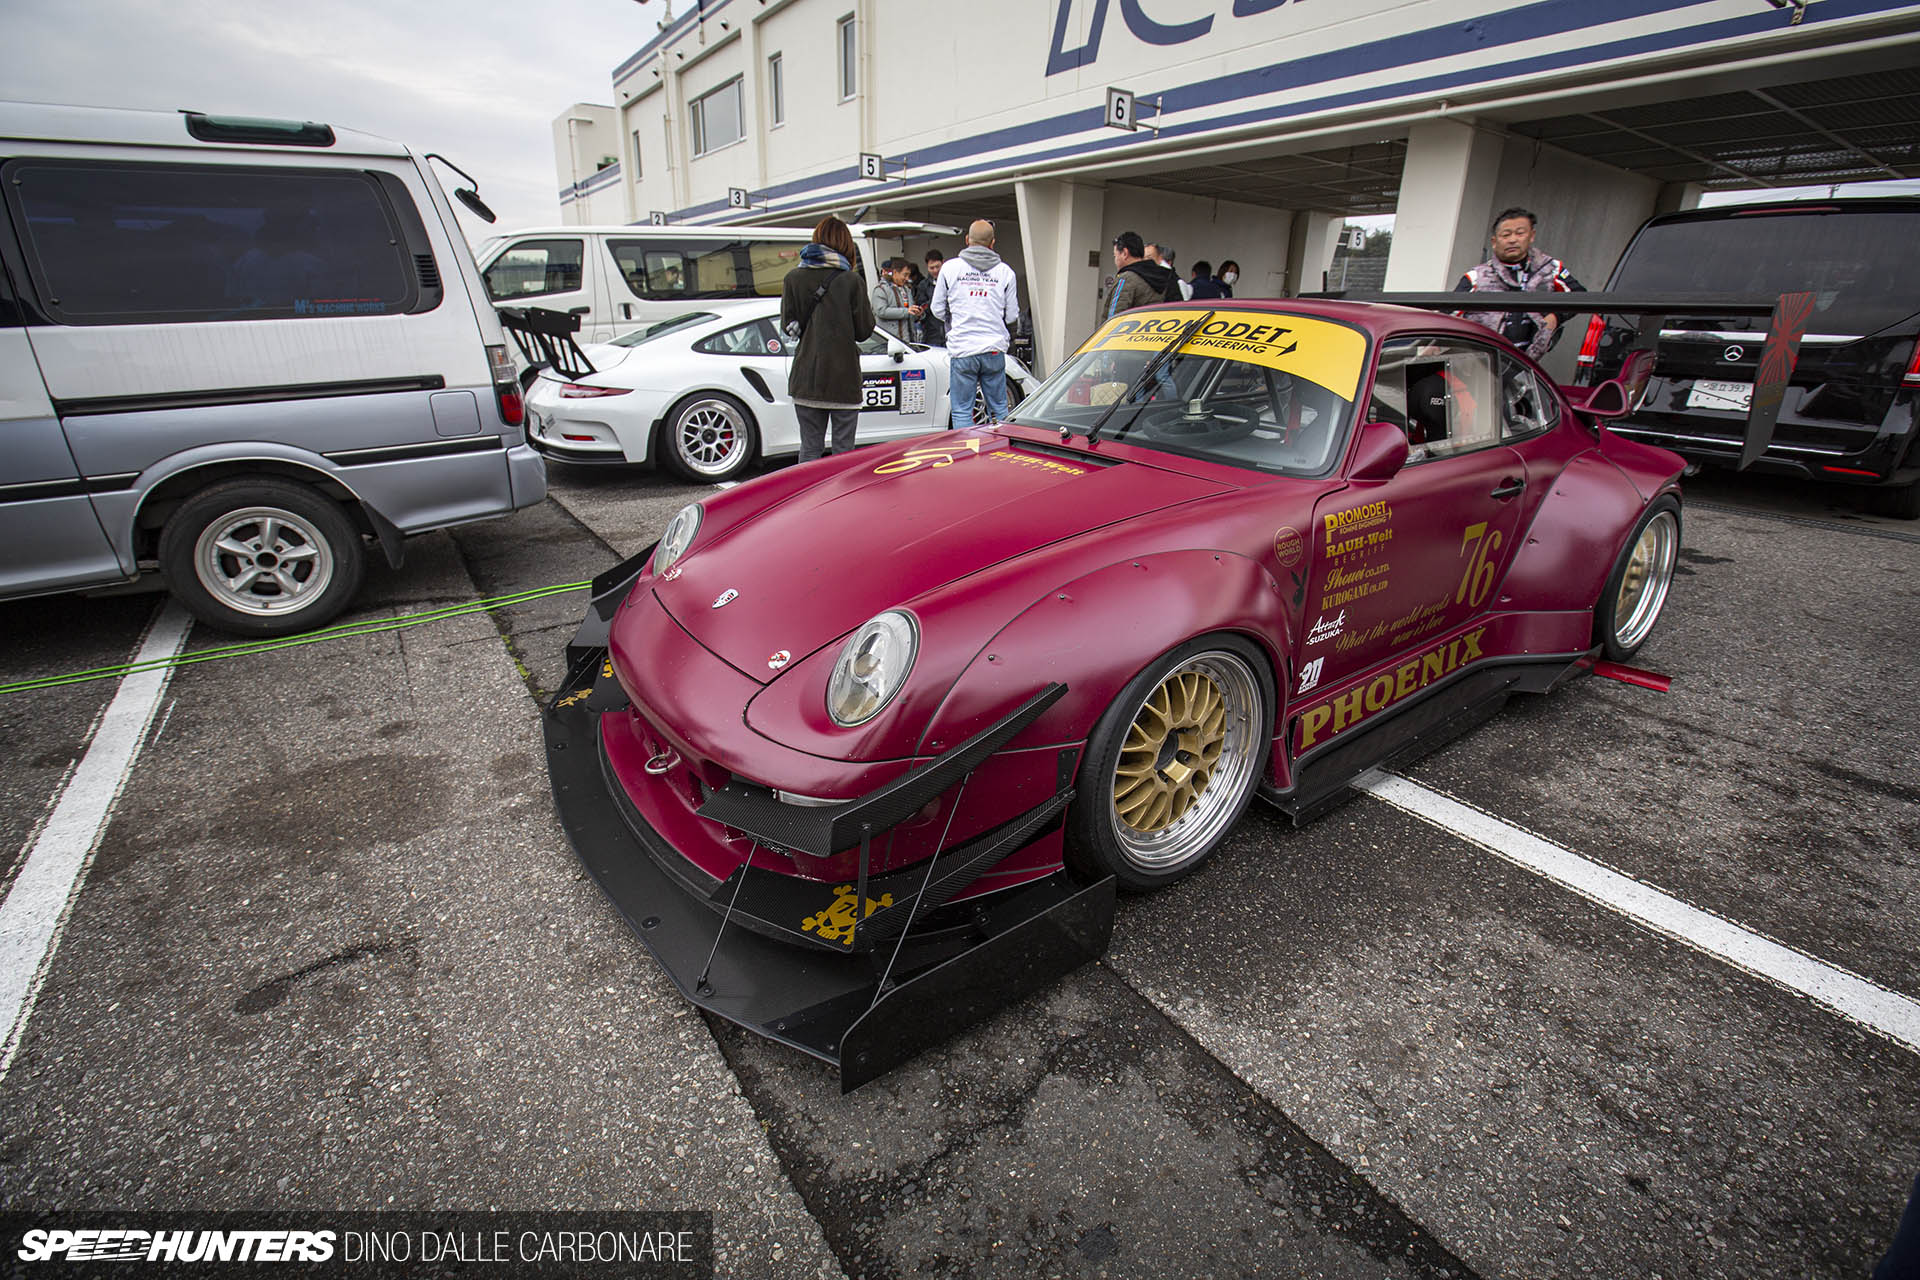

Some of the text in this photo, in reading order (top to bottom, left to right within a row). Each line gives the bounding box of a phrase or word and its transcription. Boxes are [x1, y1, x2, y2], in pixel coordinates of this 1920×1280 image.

[1114, 97, 1125, 120] 6
[867, 158, 875, 175] 5
[734, 191, 741, 204] 3
[655, 214, 661, 225] 2
[1355, 232, 1362, 247] 5
[1126, 335, 1267, 355] KOMINE GINEERING
[866, 389, 892, 406] 85
[1728, 384, 1745, 393] 393
[989, 450, 1085, 476] RAUH-Welt
[1324, 501, 1386, 544] PROMODET
[1277, 537, 1300, 551] ROUGH
[1278, 545, 1301, 558] WORLD
[1326, 528, 1392, 558] RAUH-Welt
[1455, 521, 1502, 607] 76
[1321, 582, 1370, 611] KUROGANE
[1307, 608, 1346, 640] Attack
[1335, 628, 1371, 654] What
[1369, 620, 1389, 640] the
[1300, 627, 1487, 750] PHOENIX
